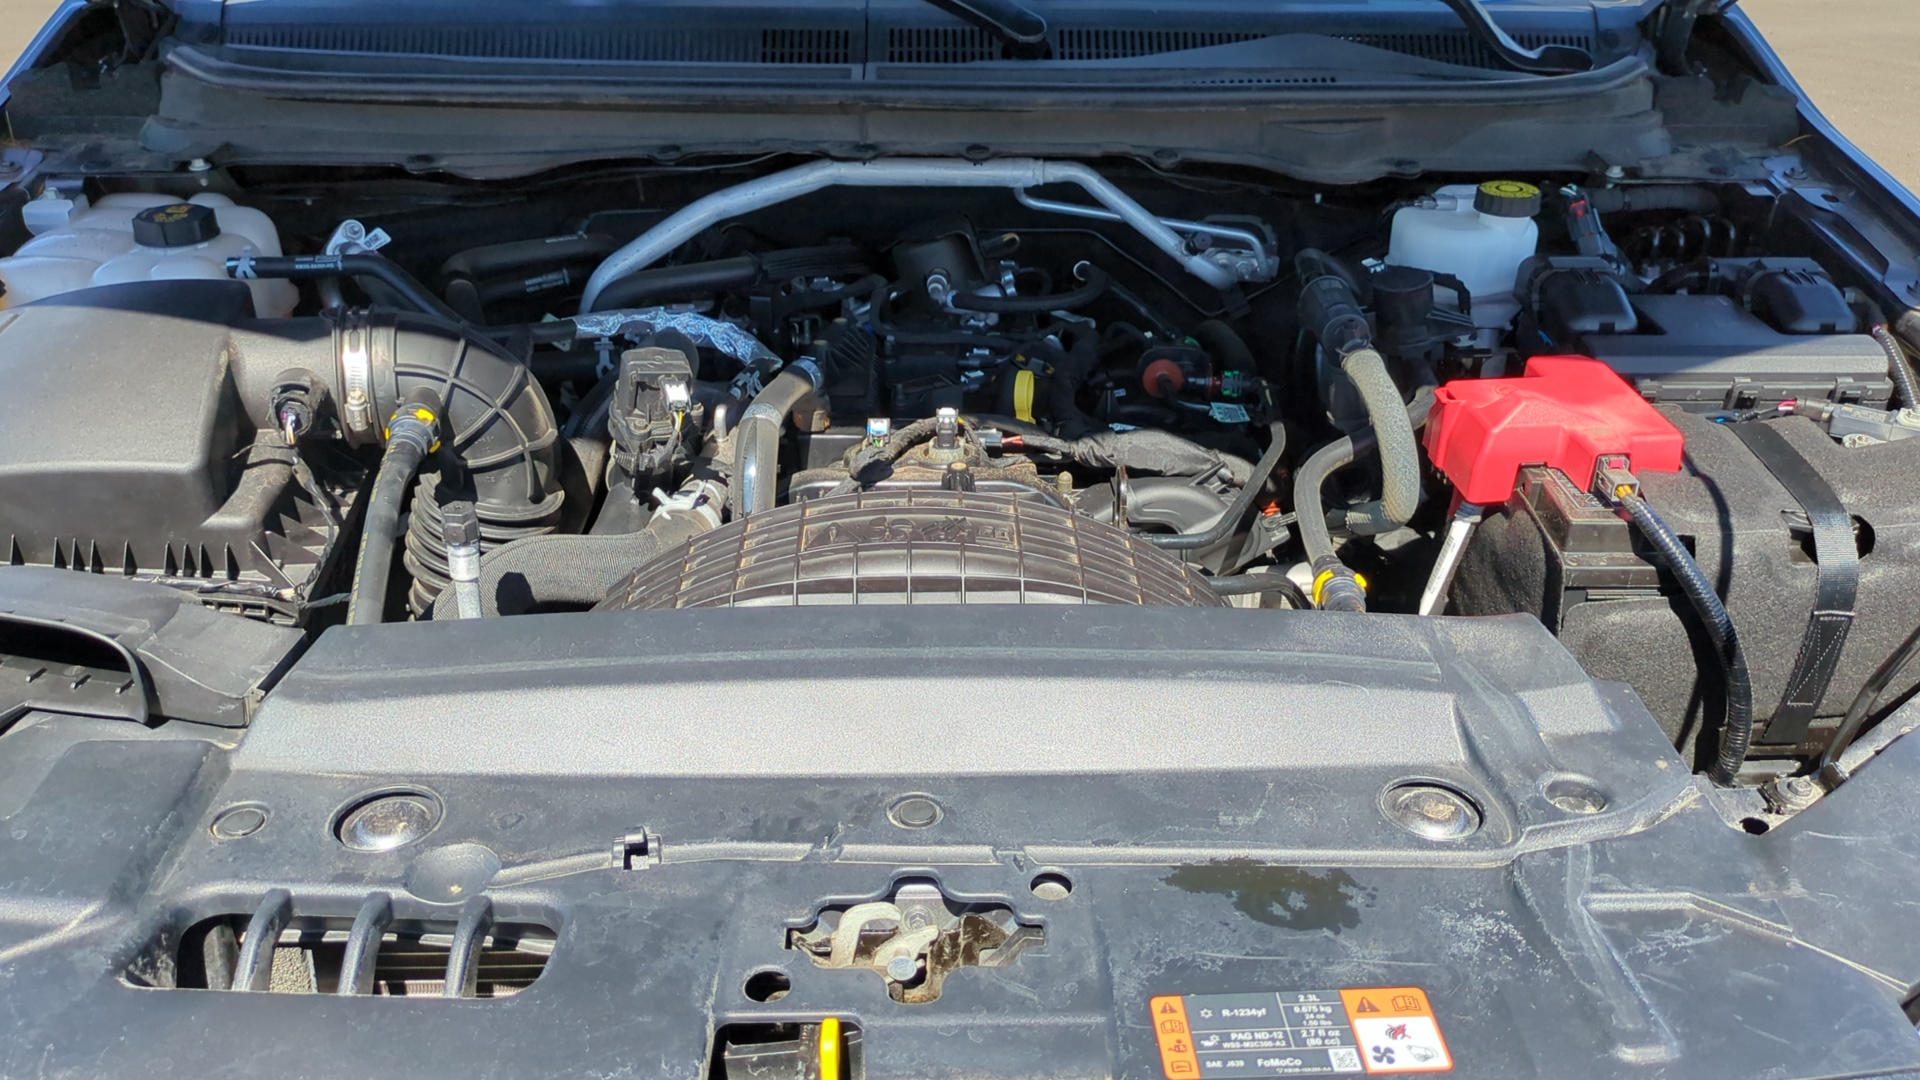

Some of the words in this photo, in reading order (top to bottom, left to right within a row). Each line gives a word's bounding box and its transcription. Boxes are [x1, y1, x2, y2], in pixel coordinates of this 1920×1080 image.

[1298, 994, 1321, 1002] 2.3L
[1221, 1007, 1267, 1018] R-1234yf
[1293, 1005, 1318, 1013] 0.675
[1319, 1005, 1333, 1014] kg
[1230, 1032, 1252, 1041] PAG
[1254, 1031, 1284, 1040] ND-12
[1300, 1029, 1316, 1038] 2.7
[1317, 1029, 1326, 1037] fl
[1327, 1029, 1342, 1037] oz
[1306, 1037, 1323, 1047] (80
[1324, 1037, 1341, 1046] cc)
[1205, 1060, 1223, 1069] SAE
[1256, 1057, 1303, 1068] FoMoCo
